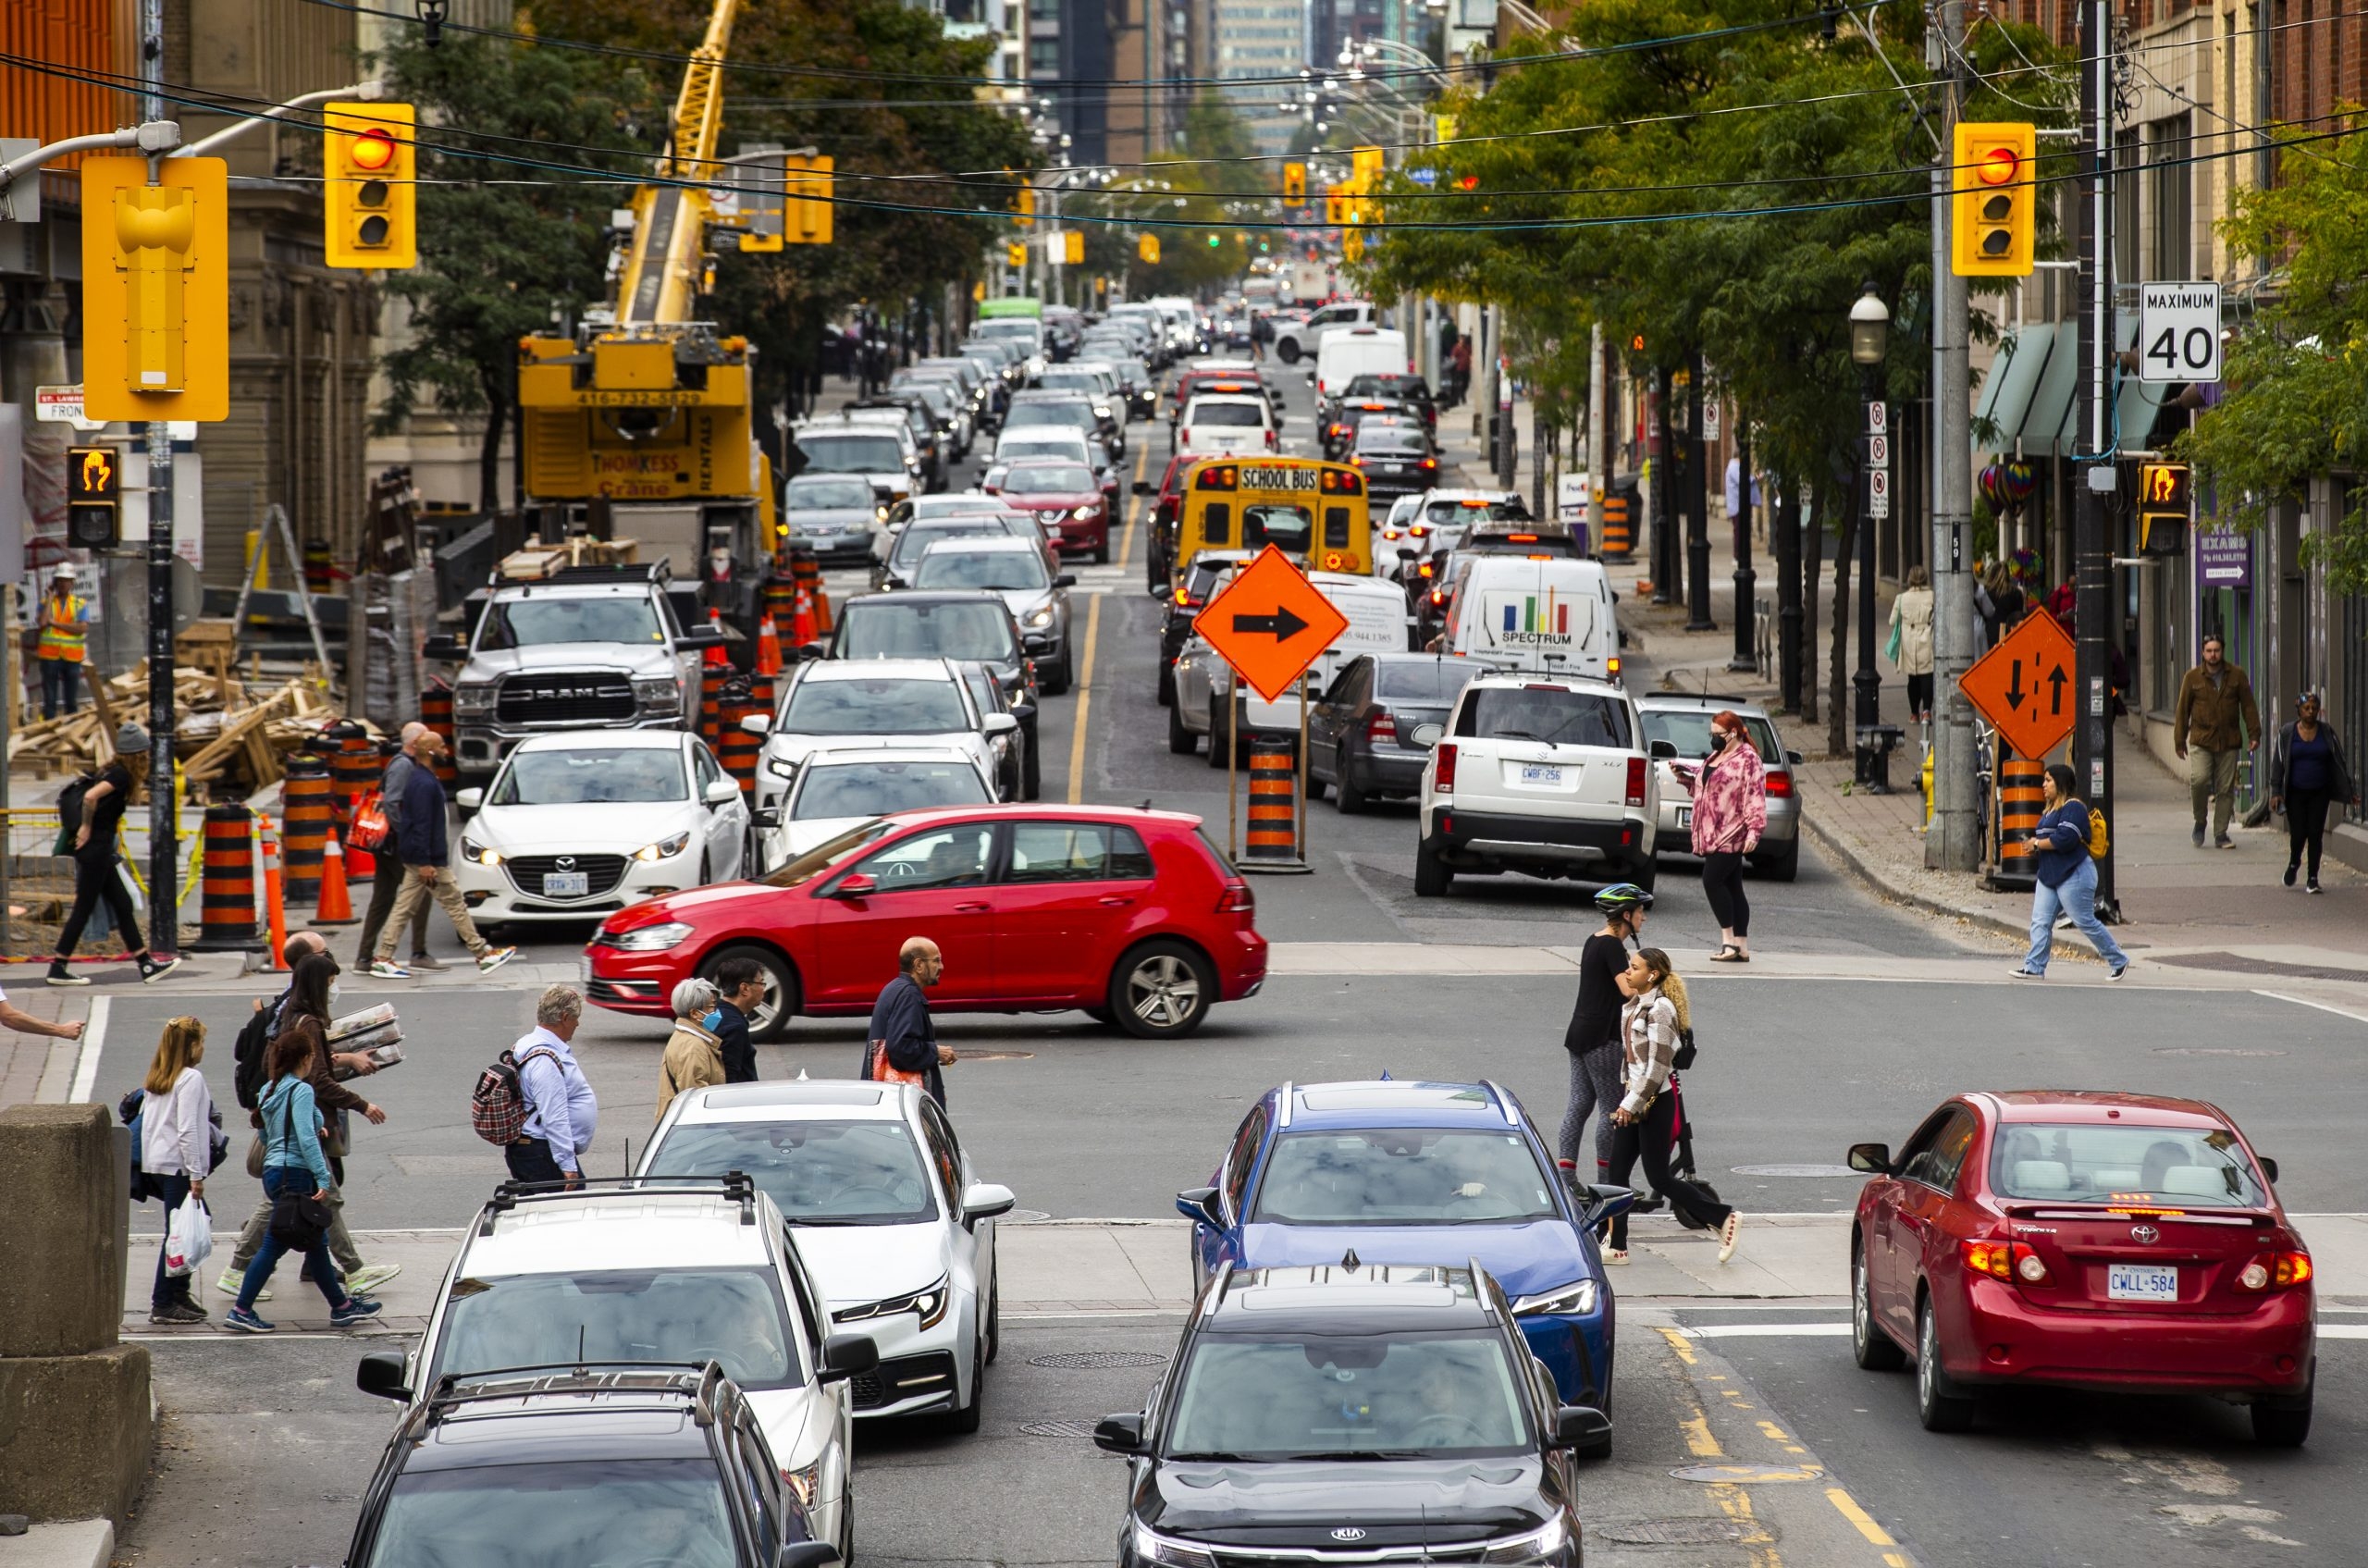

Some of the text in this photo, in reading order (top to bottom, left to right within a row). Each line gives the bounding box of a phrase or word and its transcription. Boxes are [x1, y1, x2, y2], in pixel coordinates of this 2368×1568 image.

[2147, 293, 2214, 309] MAXIMUM
[2147, 327, 2214, 369] 40
[51, 404, 82, 418] FRON
[700, 415, 712, 492] RENTALS
[1242, 469, 1315, 489] SCHOOL BUS
[598, 480, 670, 497] Crane
[1953, 537, 1959, 558] 59
[2202, 537, 2247, 550] EXAMS
[1342, 633, 1392, 643] 05.944.1385
[1502, 632, 1572, 645] SPECTRUM
[536, 687, 594, 698] RAM
[1337, 1527, 1361, 1537] KIA
